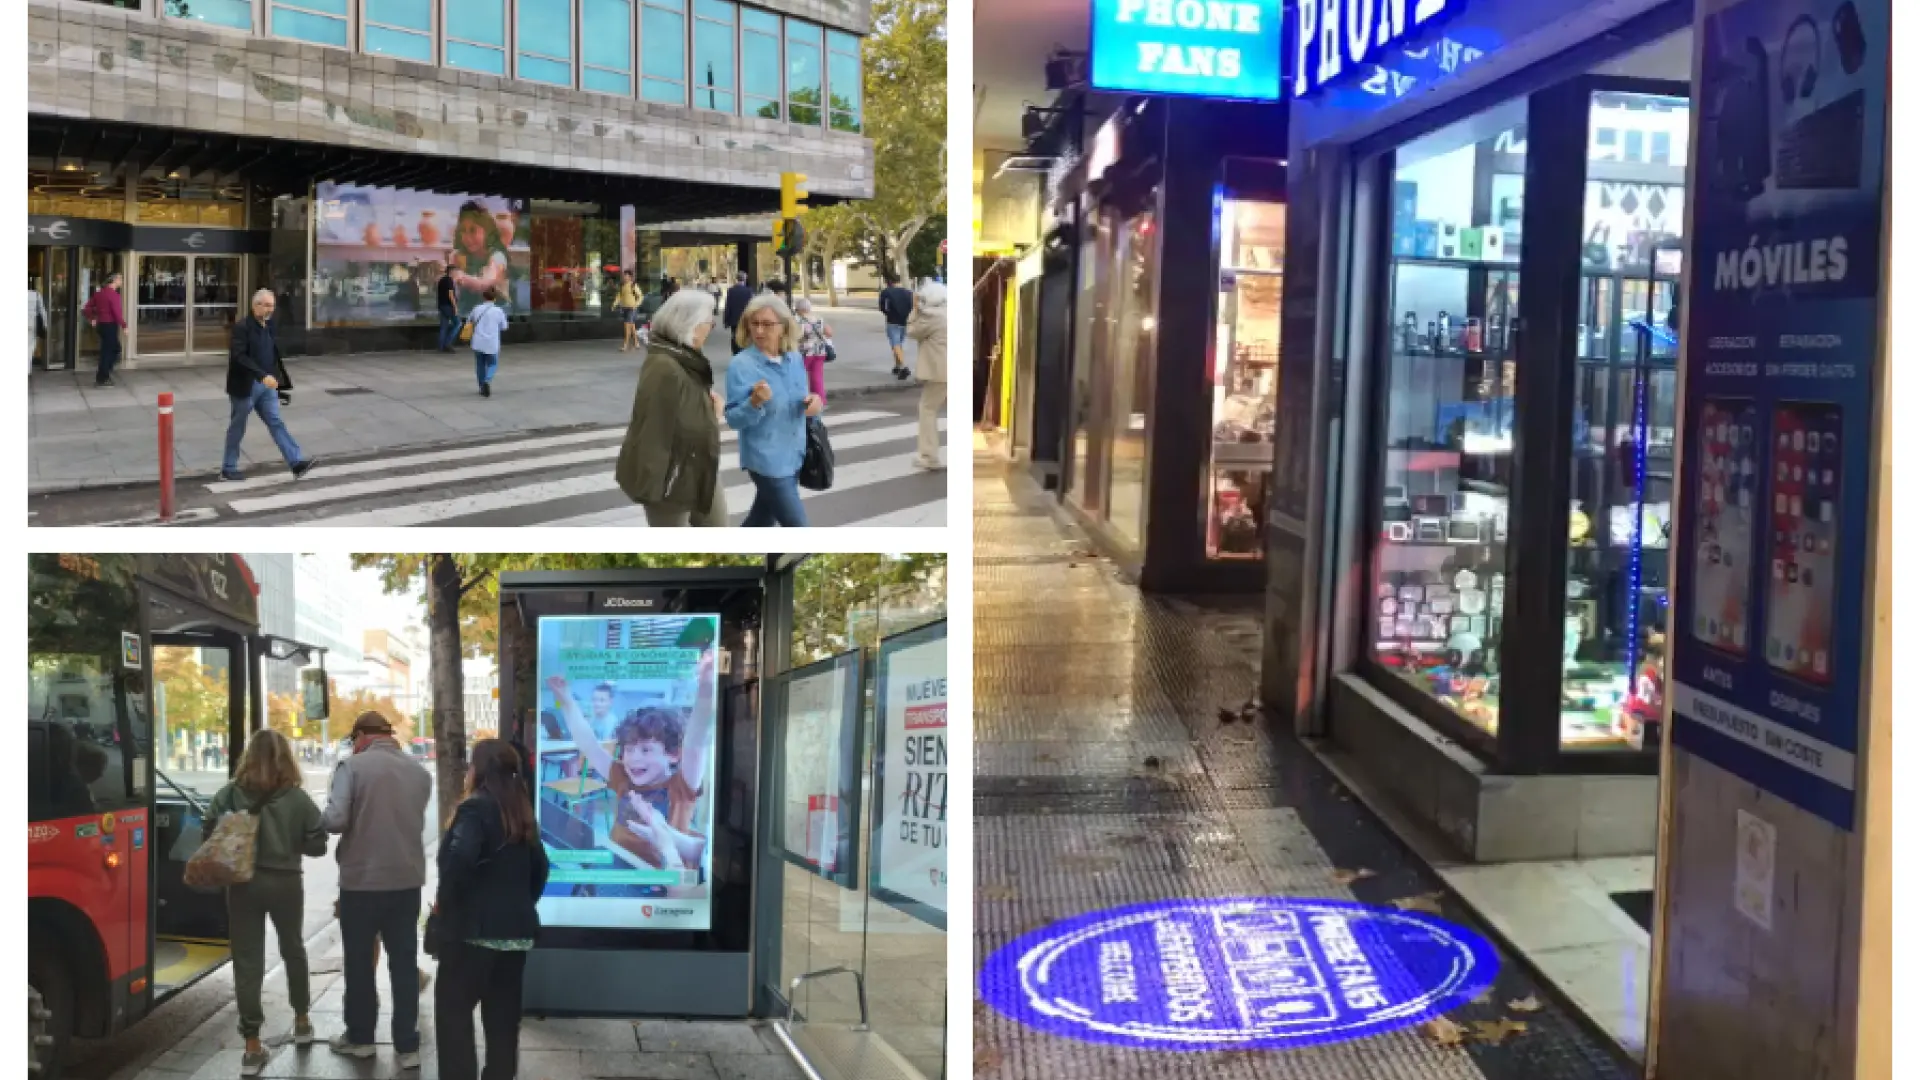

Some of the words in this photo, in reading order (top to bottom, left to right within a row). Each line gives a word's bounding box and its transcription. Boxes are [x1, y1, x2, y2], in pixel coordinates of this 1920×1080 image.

[1115, 0, 1261, 32] PHONE
[1137, 41, 1241, 78] FANS
[1714, 234, 1848, 291] MÓVILES
[900, 820, 918, 844] DE
[922, 824, 941, 848] TU
